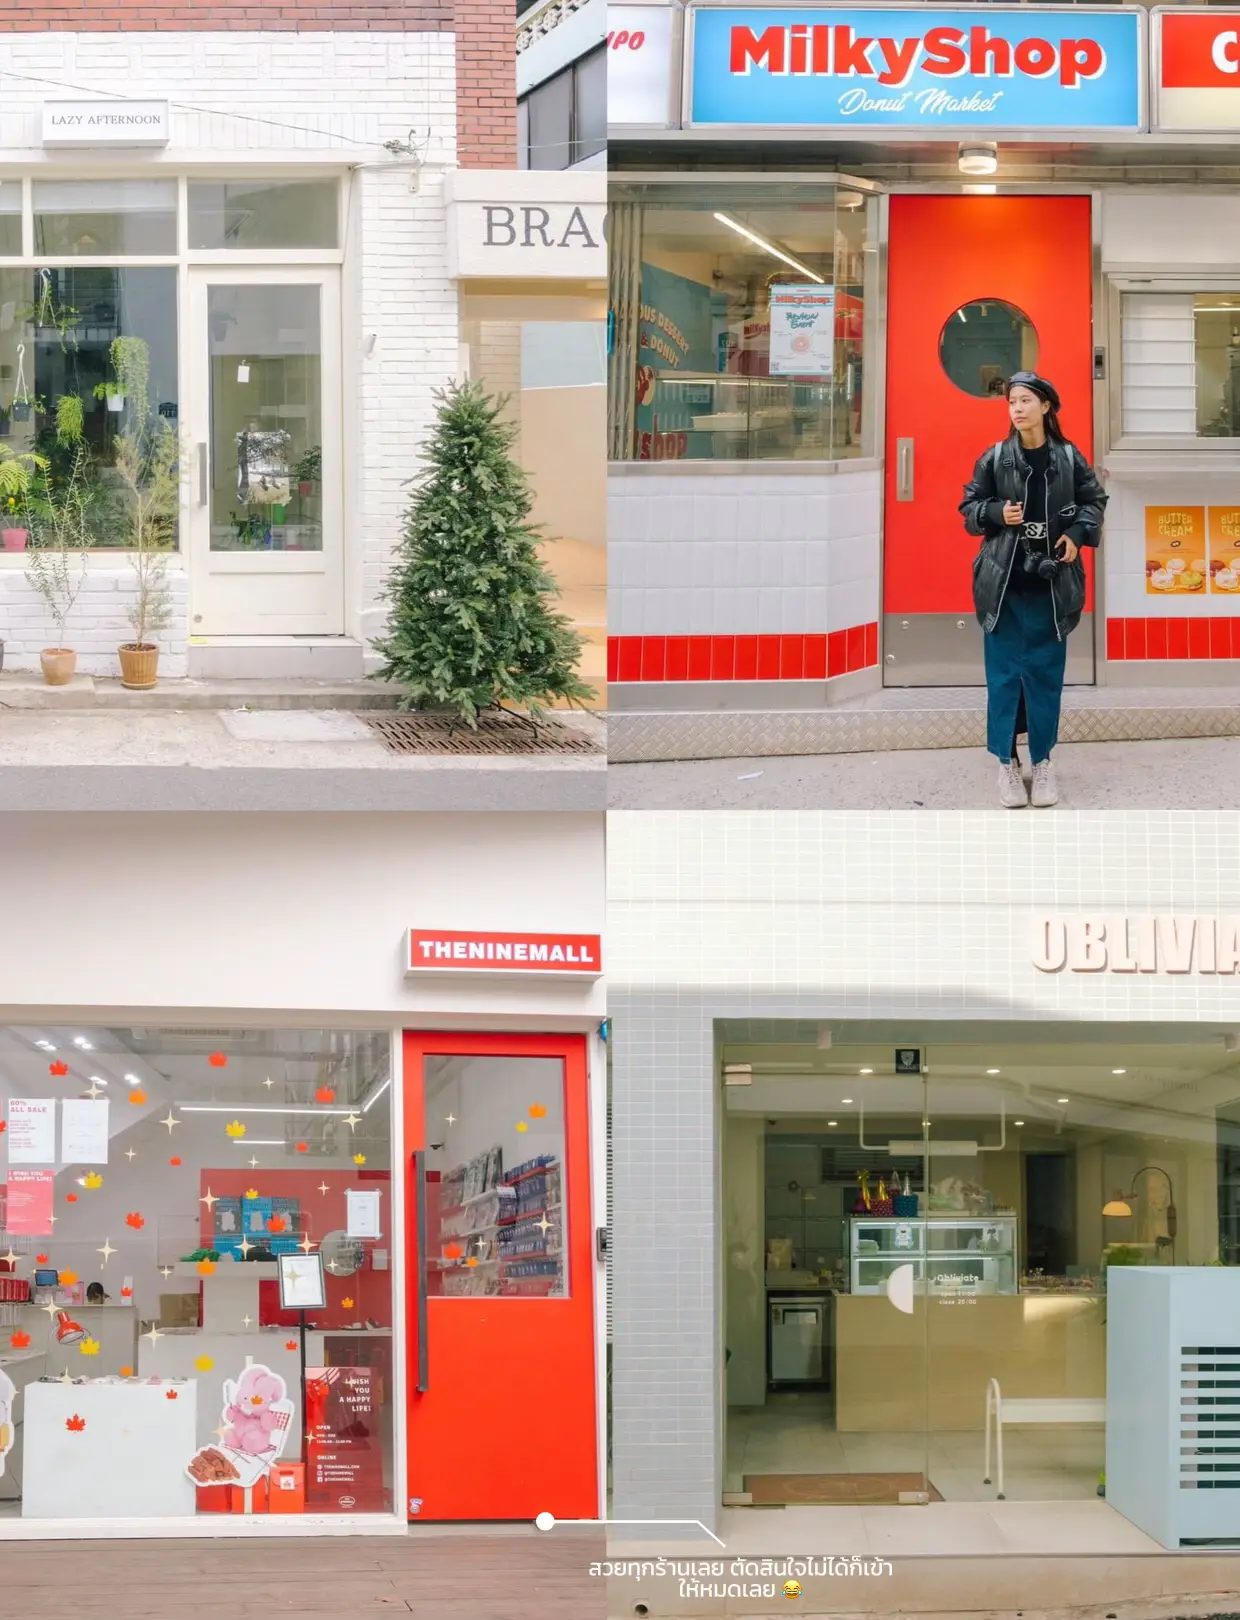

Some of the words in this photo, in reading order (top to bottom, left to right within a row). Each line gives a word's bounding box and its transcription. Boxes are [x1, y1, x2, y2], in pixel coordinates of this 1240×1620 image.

[729, 25, 1107, 89] MilkyShop
[838, 89, 906, 115] Donut
[914, 88, 1004, 116] Market
[51, 115, 83, 125] LAZY
[87, 114, 161, 125] AFTERNOON
[482, 205, 607, 248] BRA
[650, 333, 681, 369] DONUT
[1158, 511, 1194, 525] BUTTER
[1158, 524, 1194, 538] CREAM
[418, 940, 594, 963] THENINEMALL
